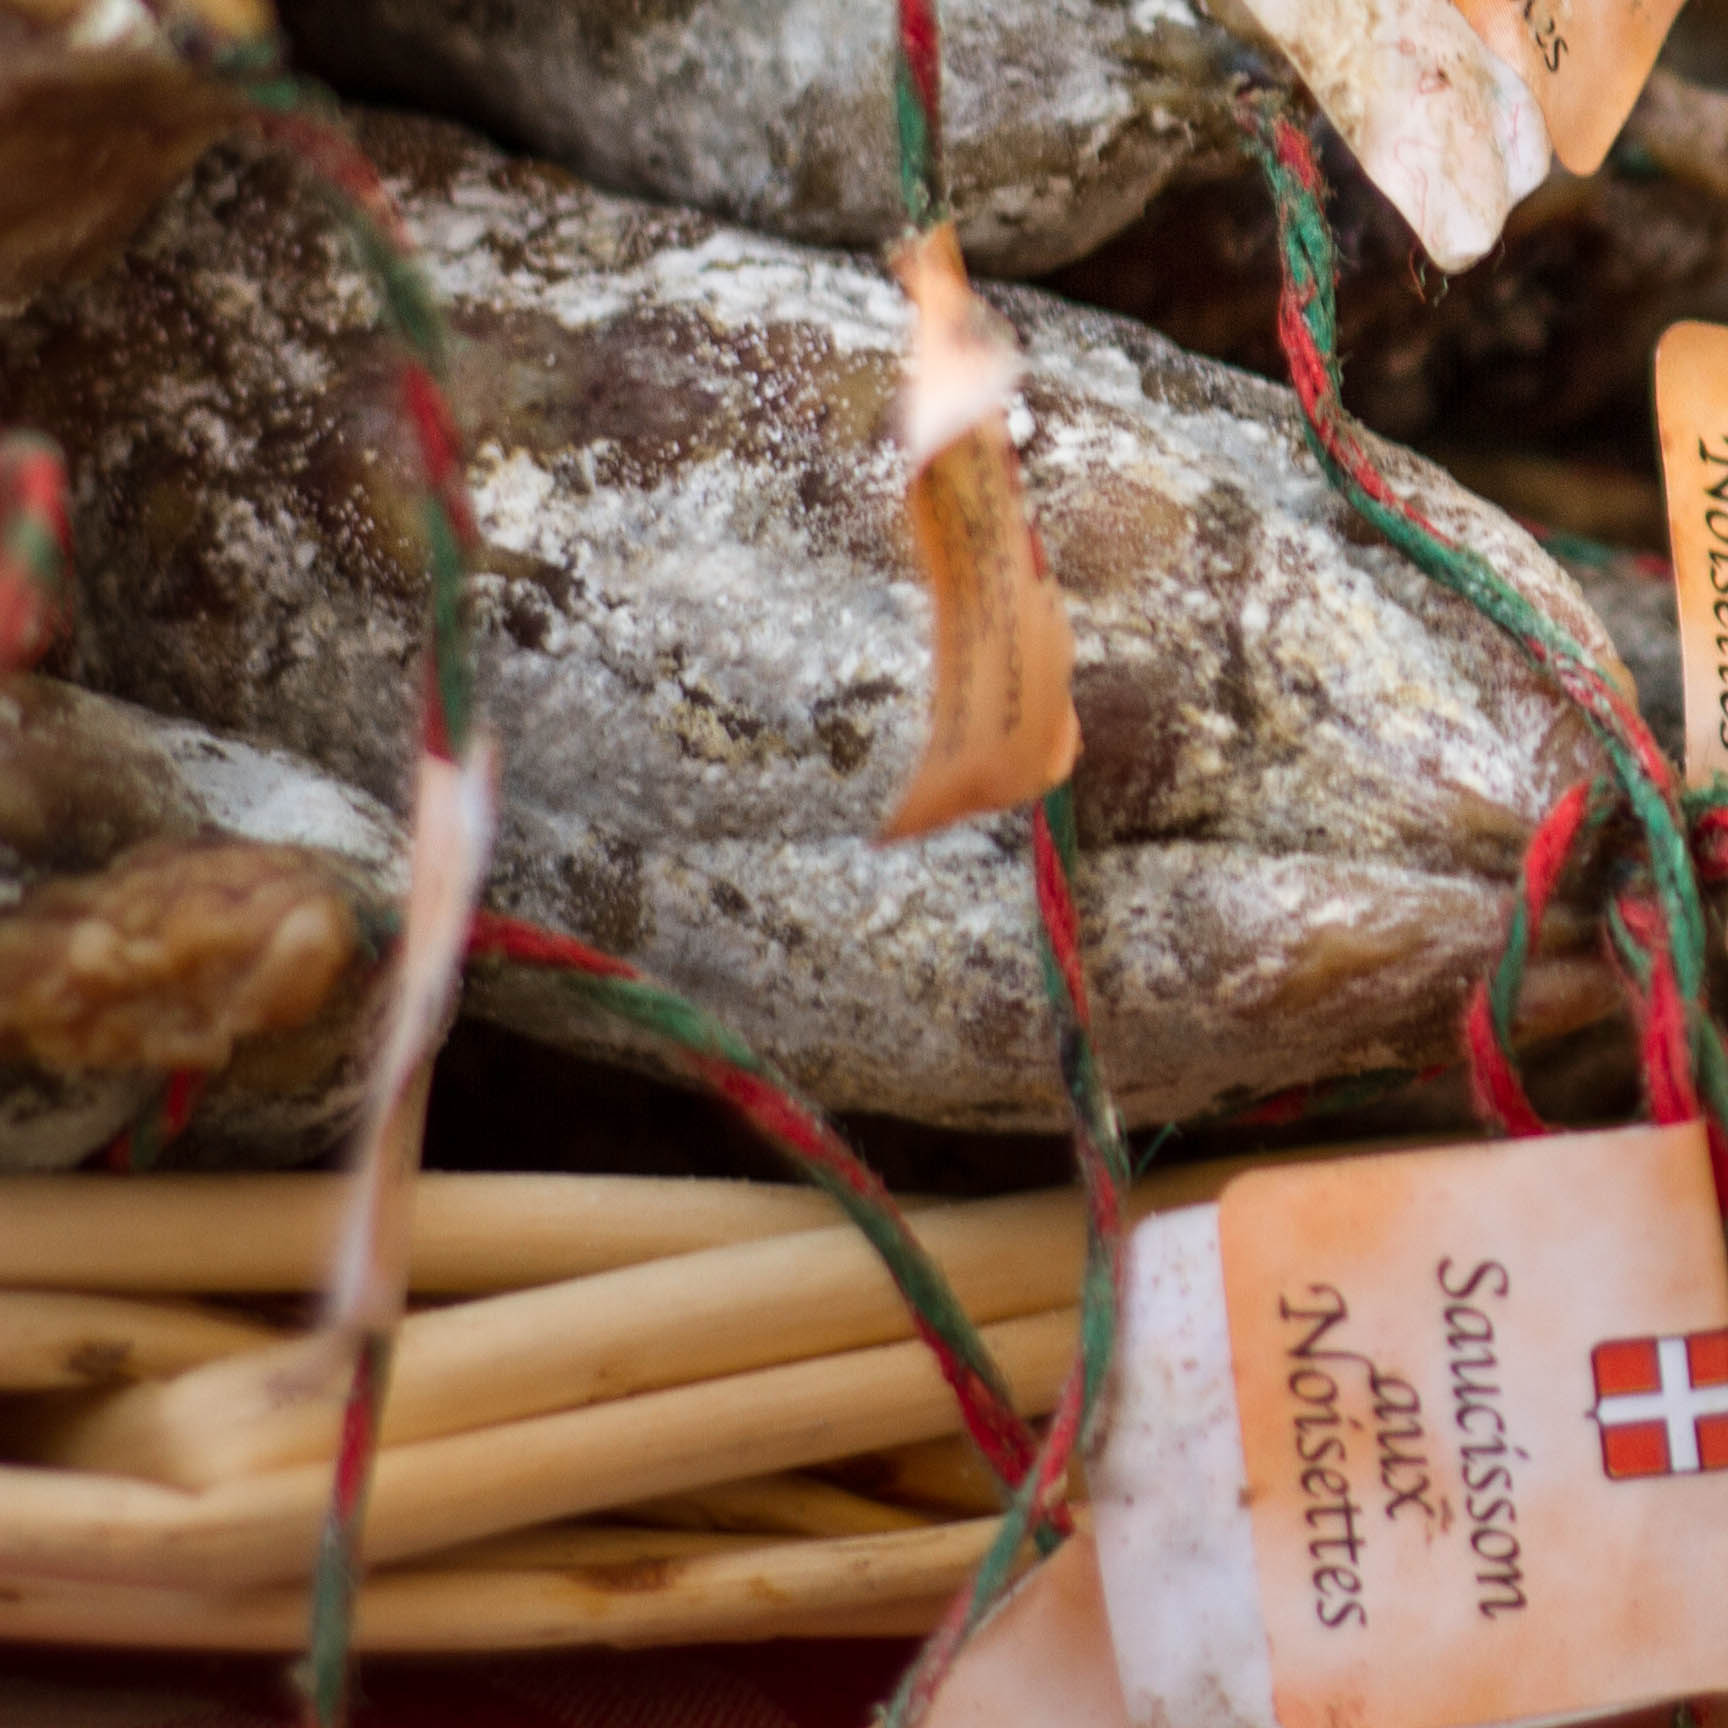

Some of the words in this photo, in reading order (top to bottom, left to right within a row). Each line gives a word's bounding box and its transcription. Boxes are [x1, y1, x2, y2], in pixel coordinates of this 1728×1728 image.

[1278, 1282, 1376, 1631] Noisettes
[1370, 1370, 1436, 1522] aux
[1435, 1256, 1529, 1620] Saucisson
